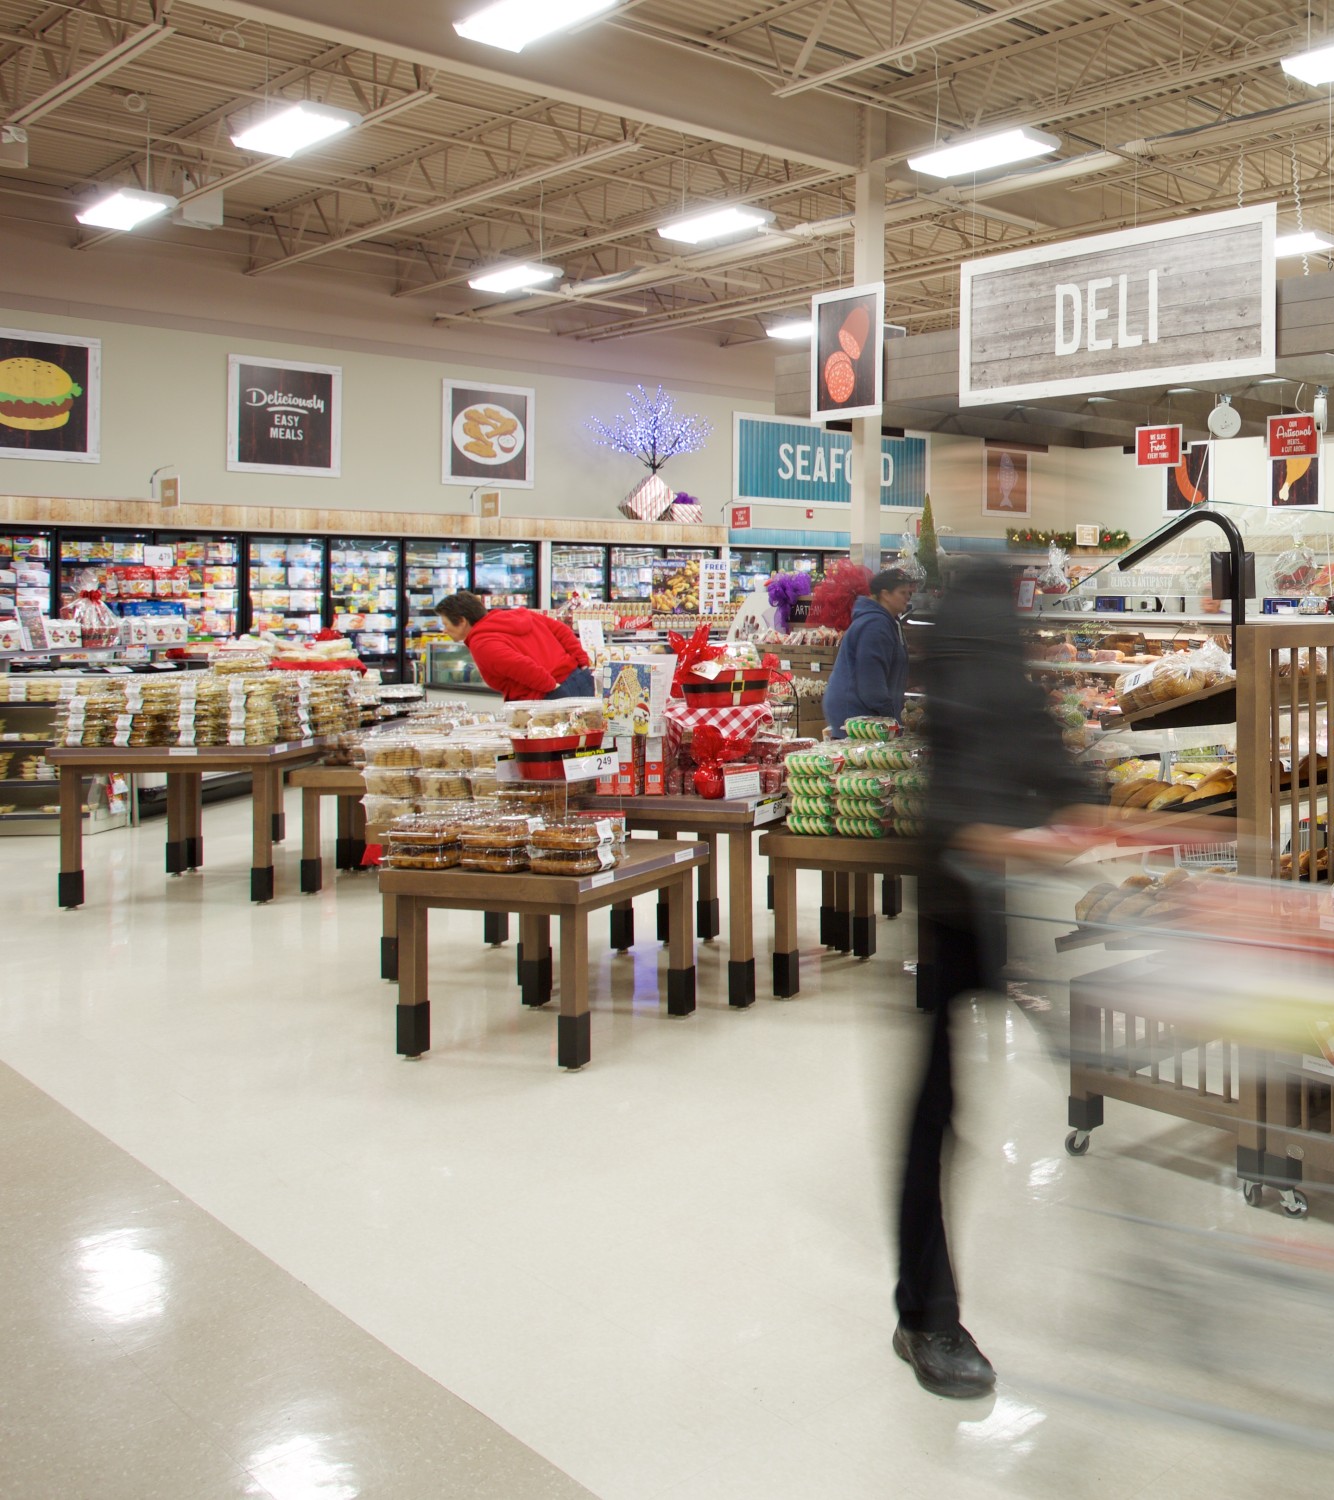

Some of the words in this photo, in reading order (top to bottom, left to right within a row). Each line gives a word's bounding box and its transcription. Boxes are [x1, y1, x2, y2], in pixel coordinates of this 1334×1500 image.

[1055, 269, 1158, 356] DELI
[245, 388, 325, 413] Deliciously
[274, 414, 300, 427] EASY
[269, 427, 304, 441] MEALS
[1275, 425, 1312, 439] Artisanal
[1149, 441, 1167, 453] Fresh
[778, 443, 894, 487] SEAFD
[1110, 576, 1132, 588] OLIVES
